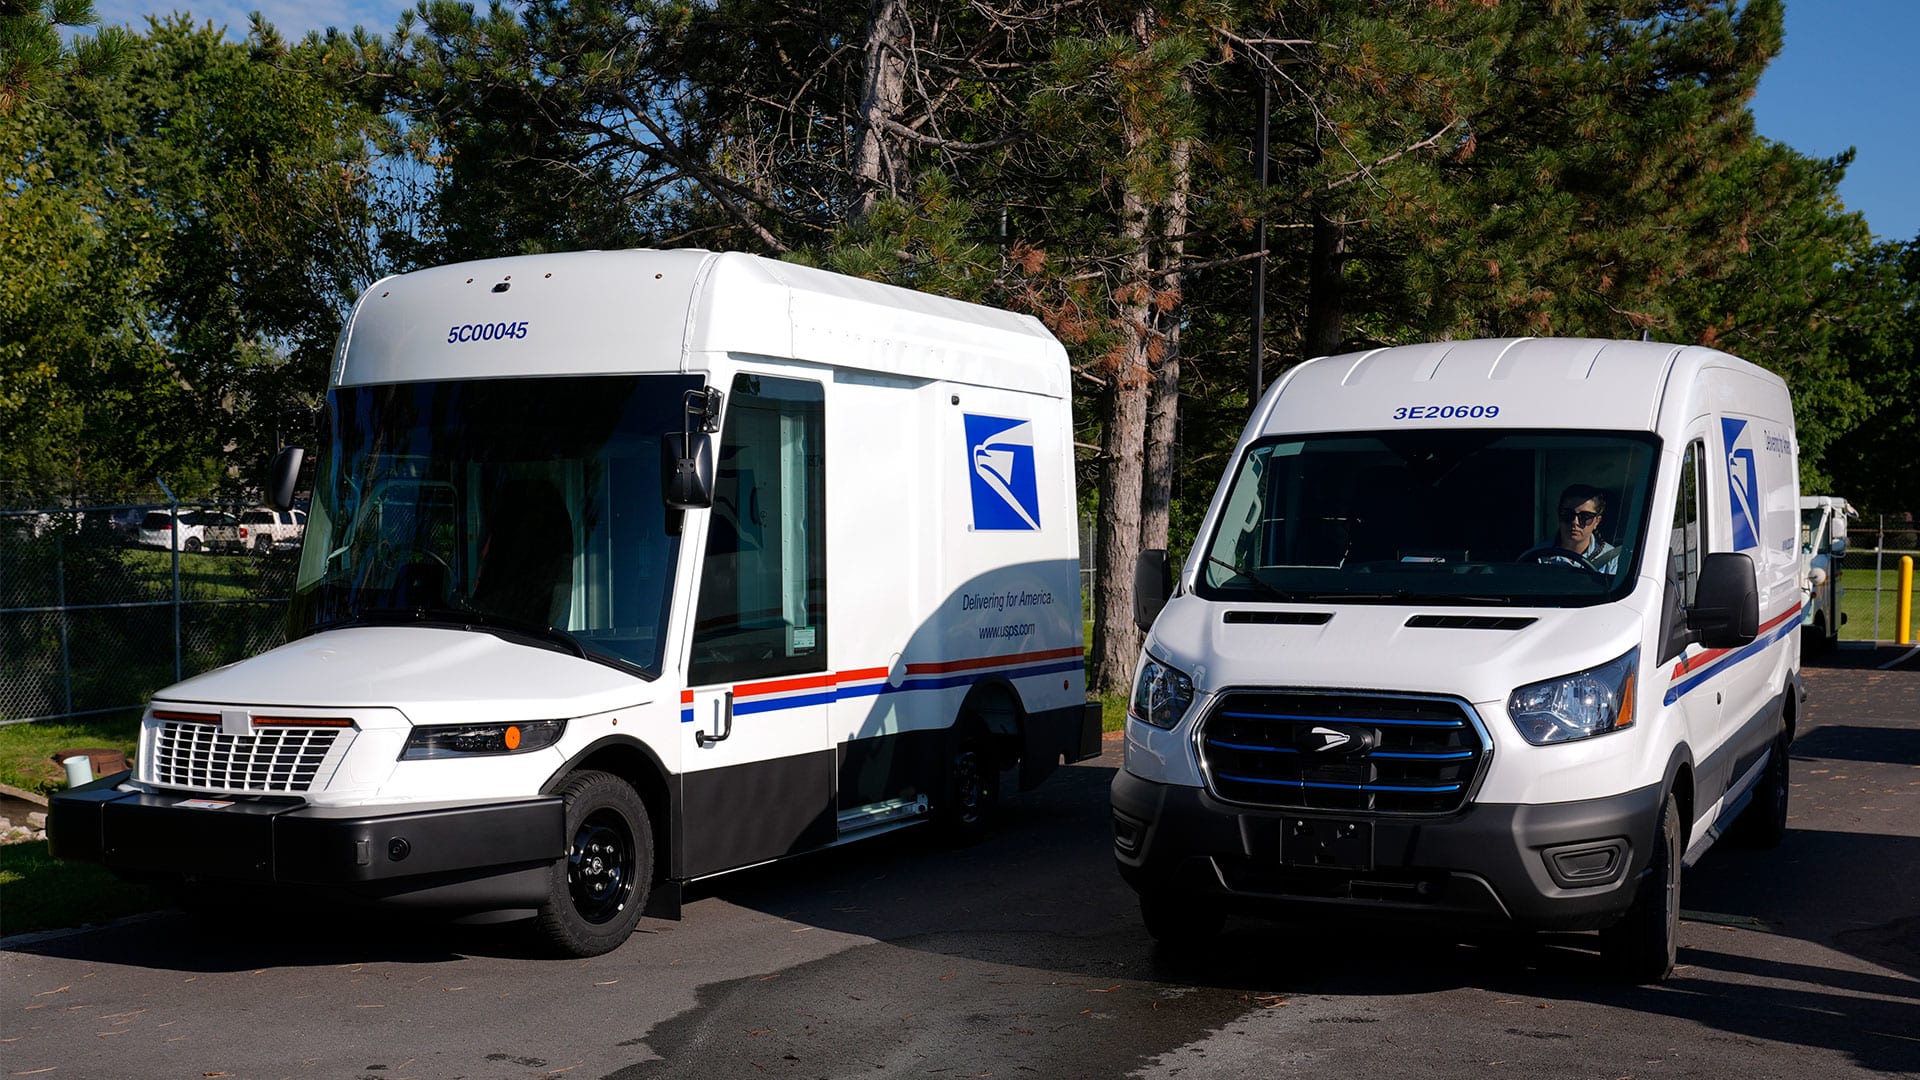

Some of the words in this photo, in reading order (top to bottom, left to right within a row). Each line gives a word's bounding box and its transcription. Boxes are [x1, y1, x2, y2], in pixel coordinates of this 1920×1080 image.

[447, 321, 529, 344] 5C00045
[1393, 405, 1500, 420] 3E20609
[962, 592, 1005, 612] Delivering
[1005, 591, 1018, 608] for
[978, 623, 1036, 640] www.usps.com
